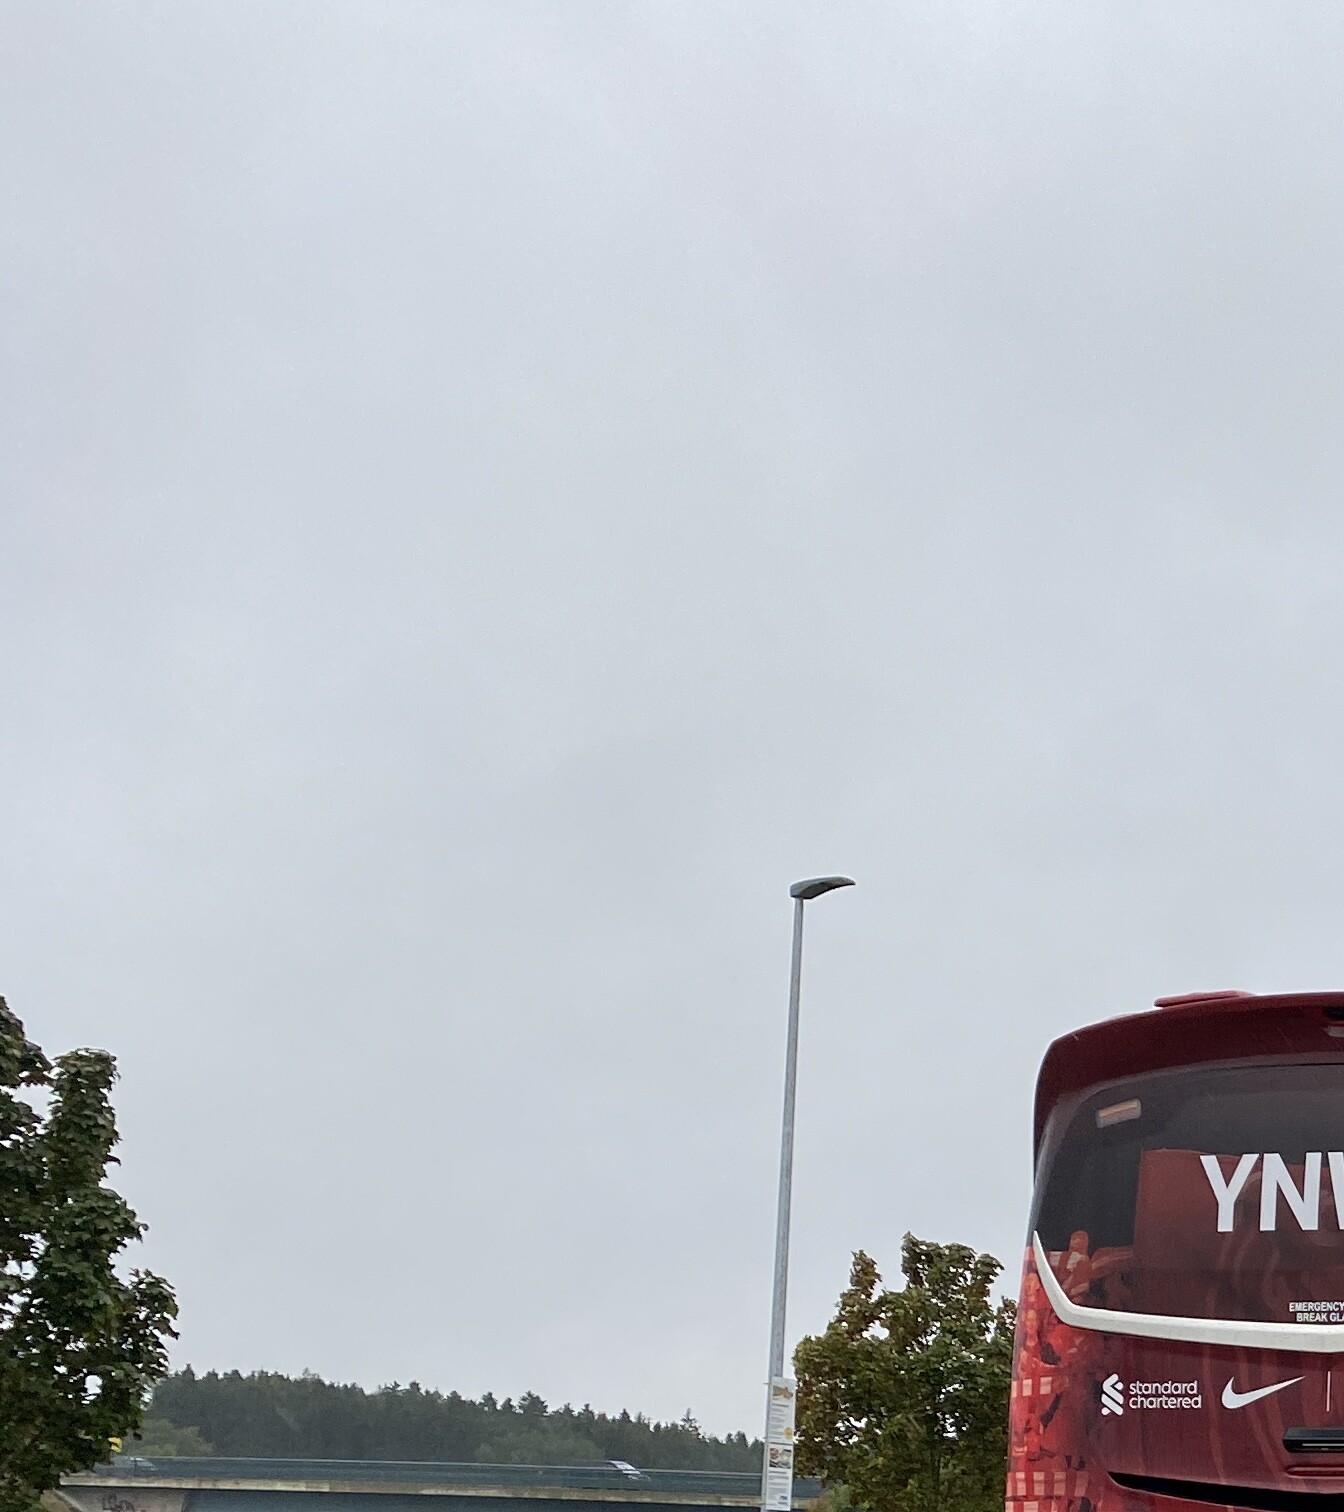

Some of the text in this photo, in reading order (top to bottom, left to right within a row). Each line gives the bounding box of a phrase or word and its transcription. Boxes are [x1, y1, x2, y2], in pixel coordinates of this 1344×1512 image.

[1289, 1301, 1344, 1312] EMERGENCY
[1296, 1312, 1328, 1322] BREAK
[1129, 1380, 1198, 1395] standard
[1129, 1395, 1202, 1409] chartered
